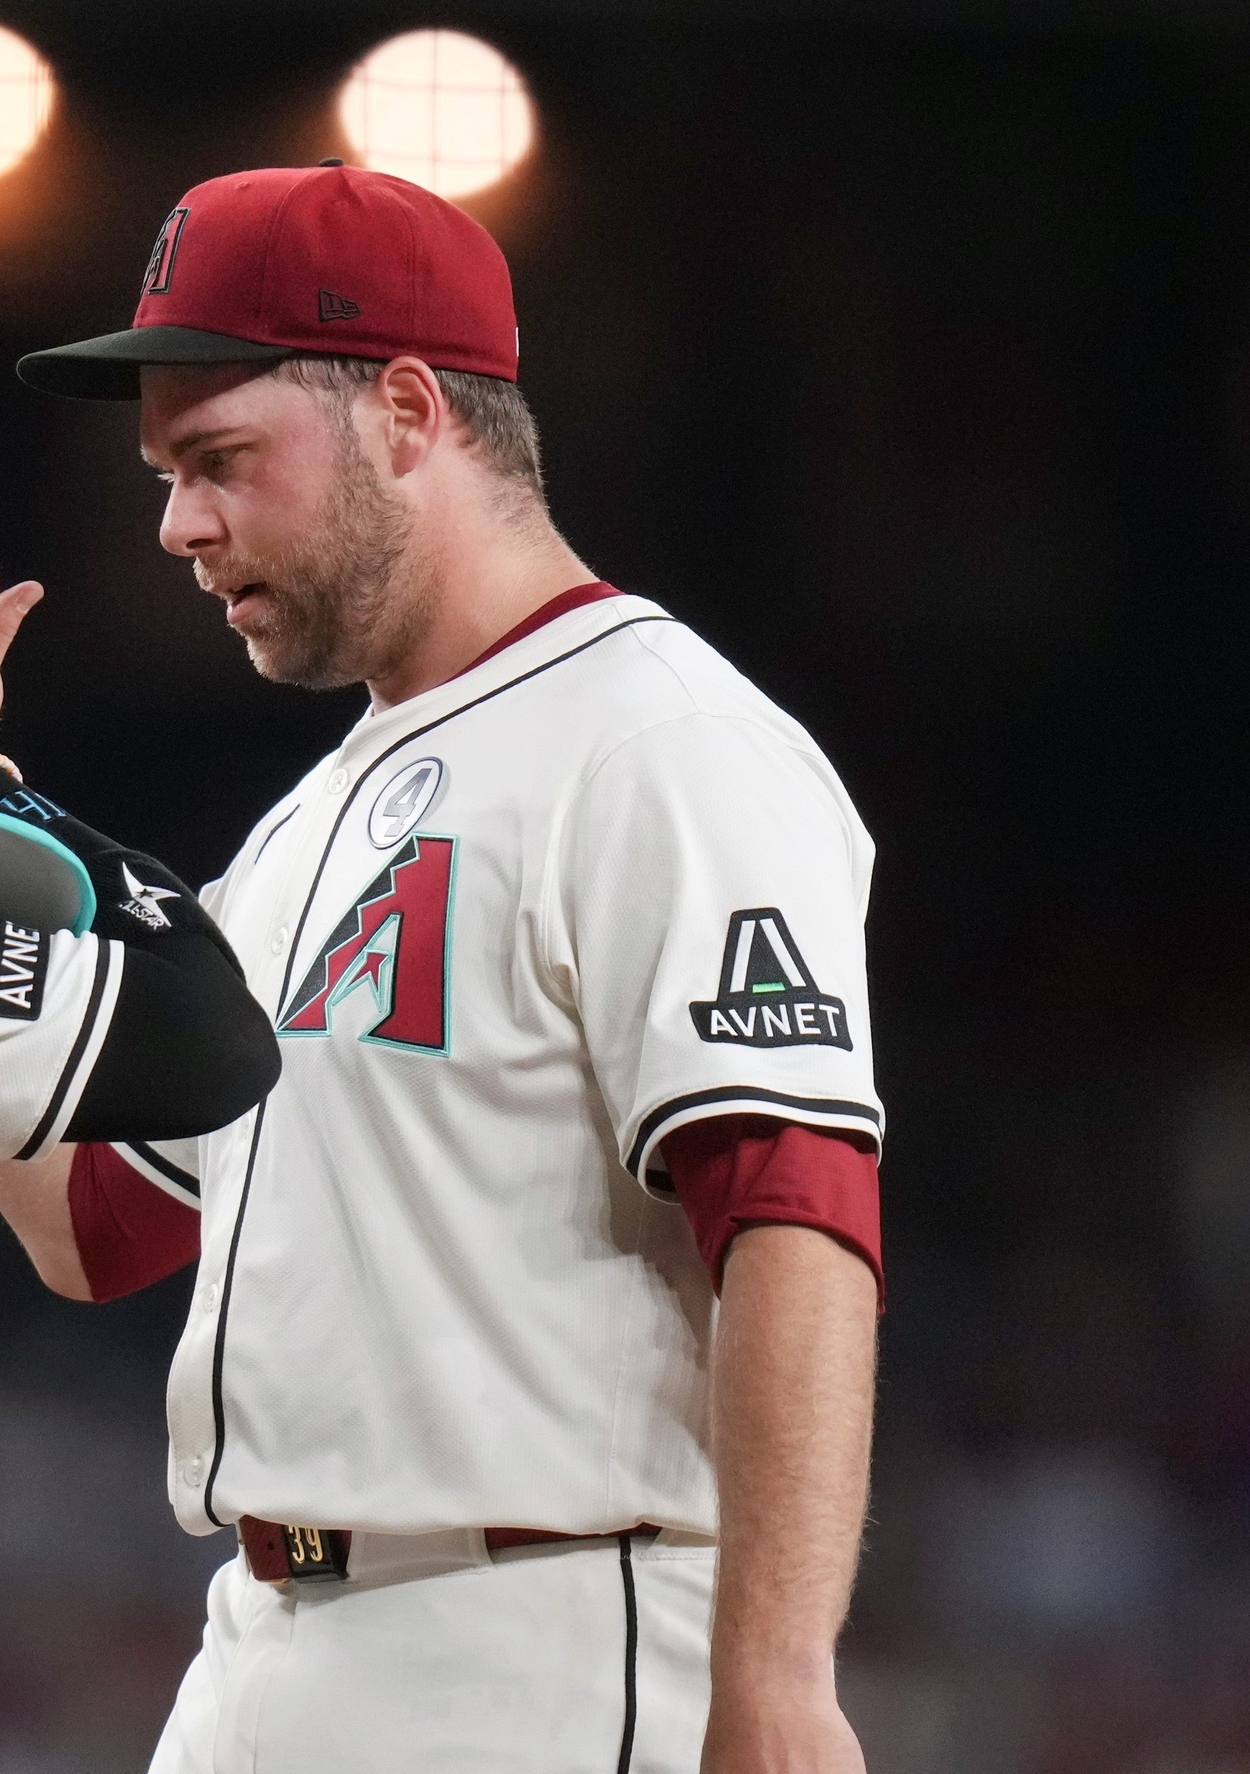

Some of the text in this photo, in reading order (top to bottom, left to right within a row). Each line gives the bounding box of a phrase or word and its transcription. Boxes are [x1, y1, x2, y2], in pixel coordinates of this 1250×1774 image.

[382, 767, 433, 838] 4
[709, 1002, 840, 1038] AVNET
[288, 1526, 323, 1564] 39
